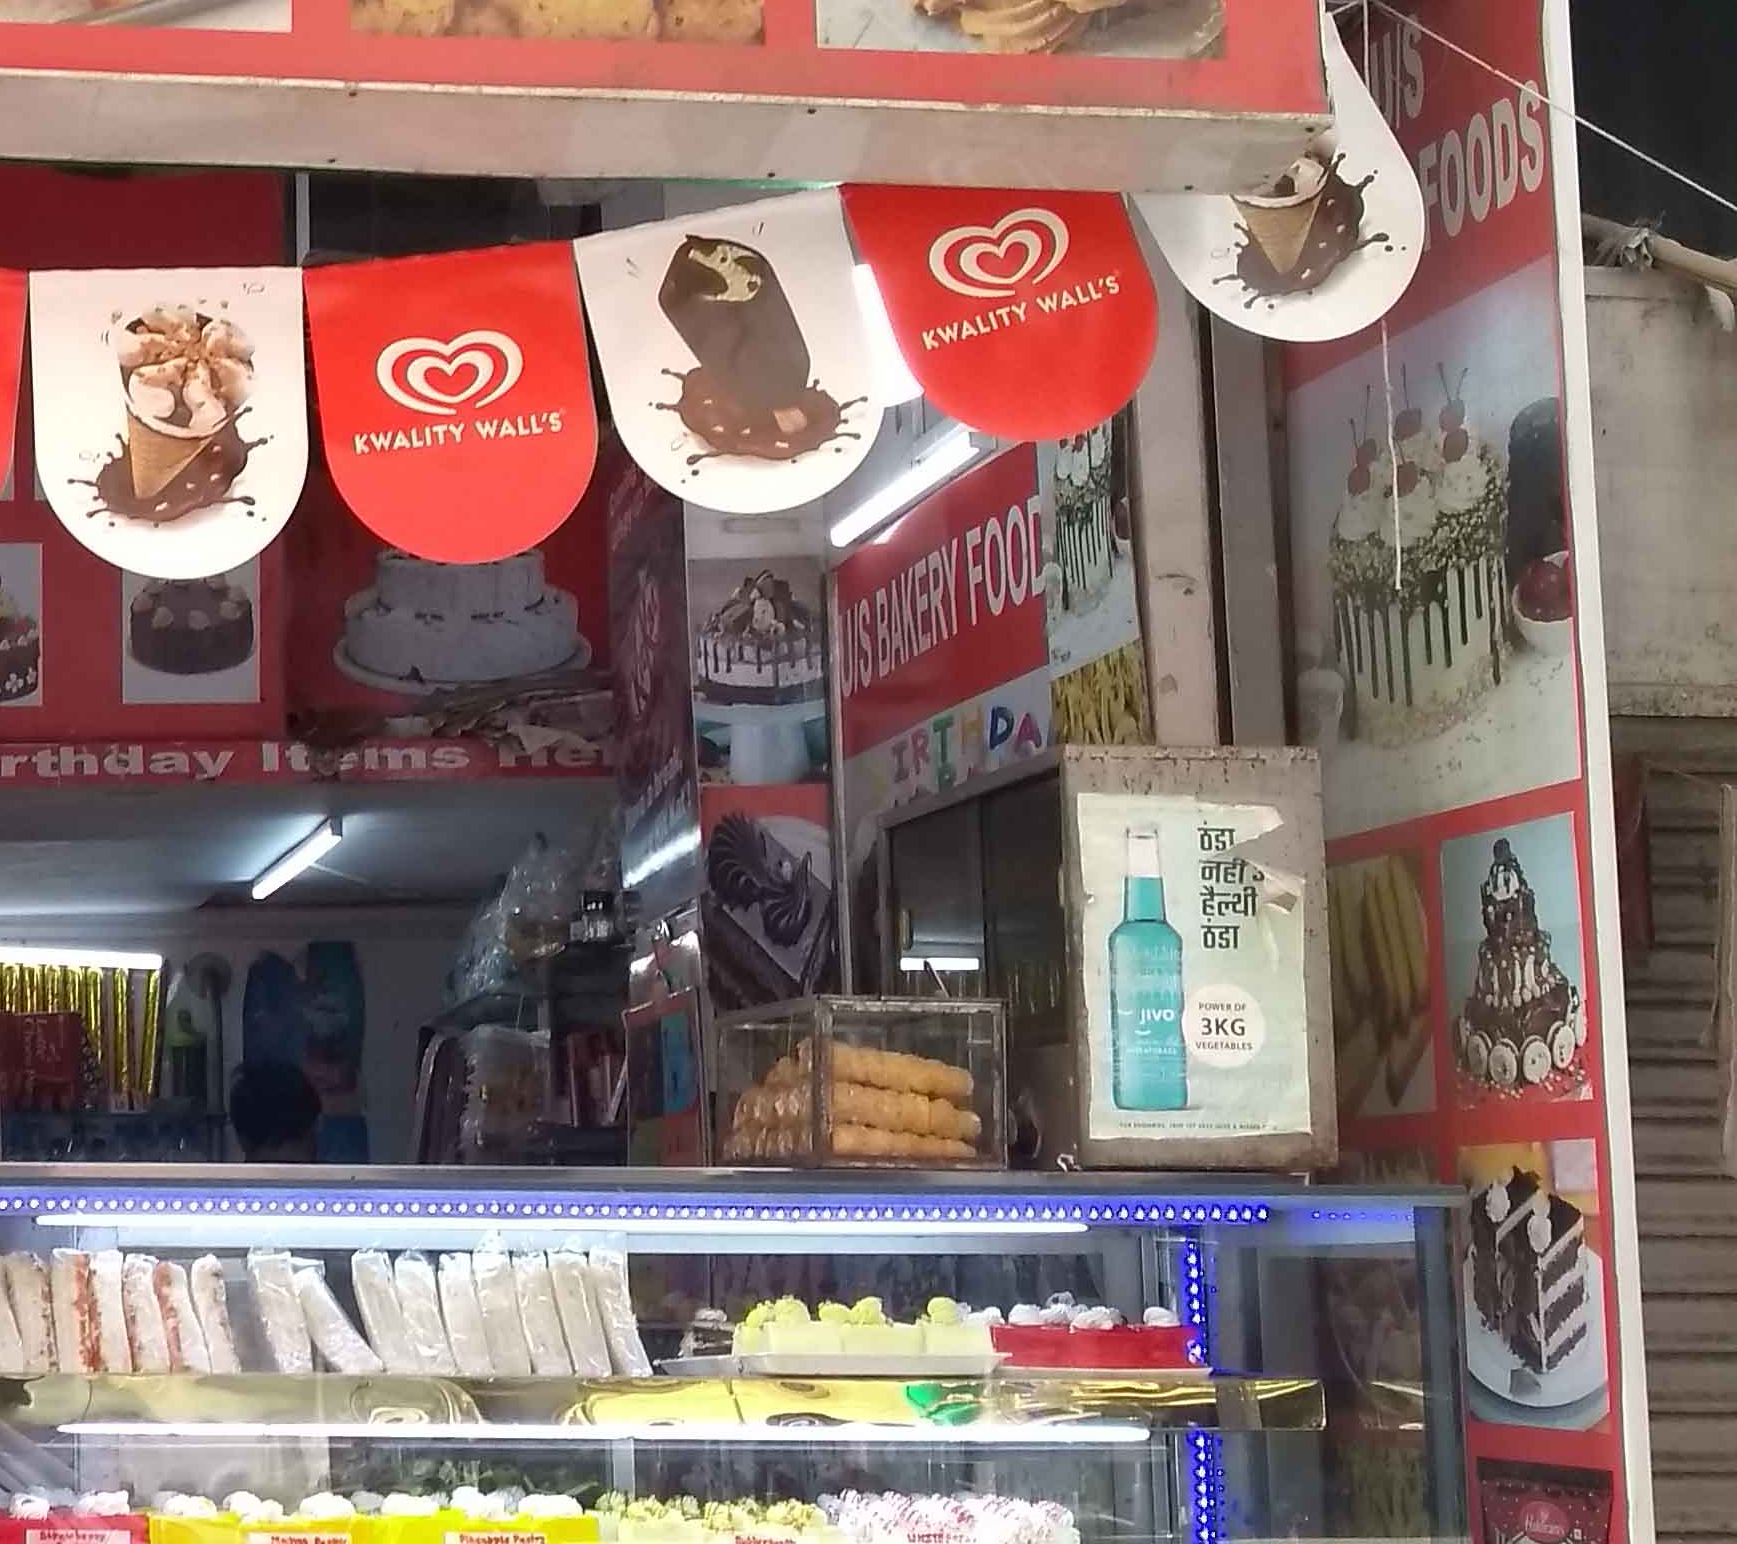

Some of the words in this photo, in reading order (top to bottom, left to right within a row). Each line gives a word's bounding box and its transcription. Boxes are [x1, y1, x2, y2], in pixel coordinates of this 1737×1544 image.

[1418, 79, 1544, 253] FOODS
[920, 303, 1028, 353] KWALITY
[1034, 275, 1121, 318] WALL'S
[352, 422, 466, 457] KWALITY
[474, 409, 563, 441] WALL'S
[875, 536, 959, 679] BAKERY
[1200, 918, 1240, 950] ठंडा
[1198, 1003, 1231, 1011] POWER
[1237, 1003, 1247, 1012] OF
[1201, 1017, 1246, 1037] 3KG
[1196, 1042, 1254, 1051] VEGETABLES
